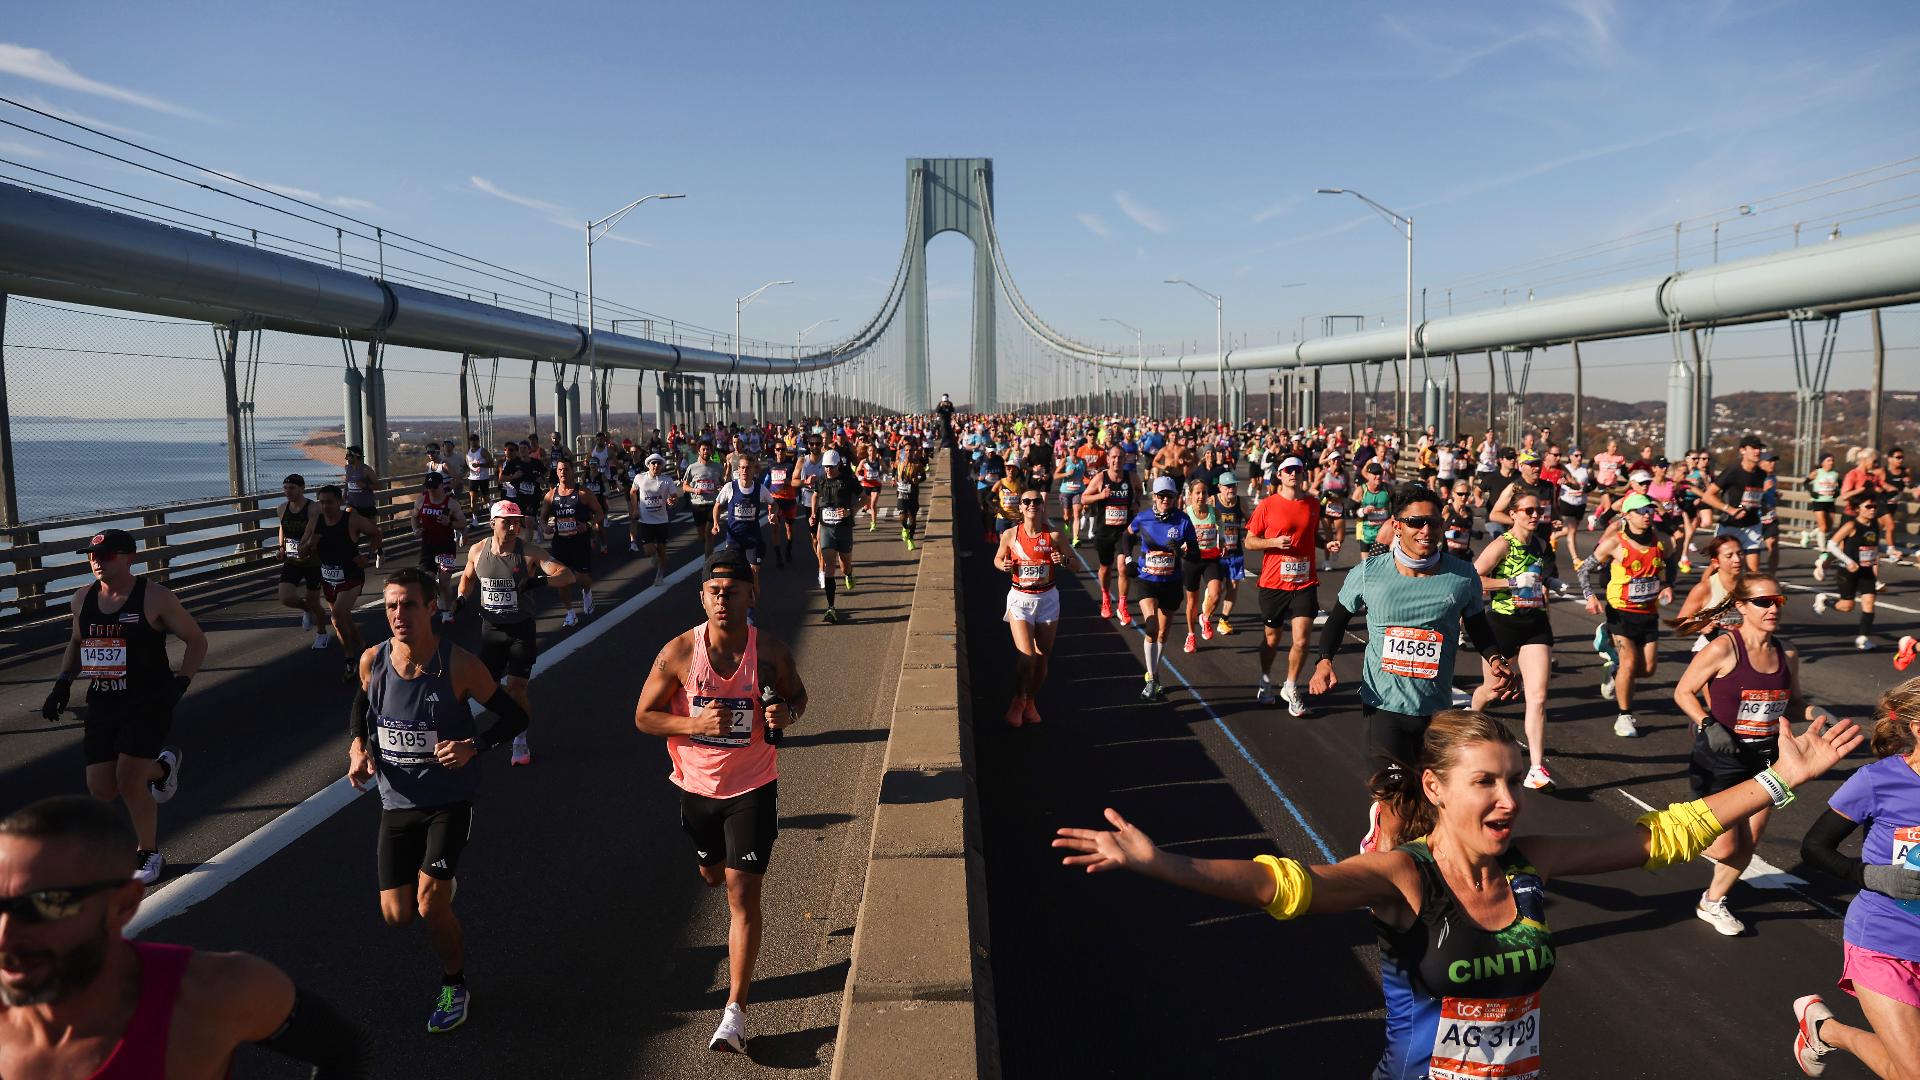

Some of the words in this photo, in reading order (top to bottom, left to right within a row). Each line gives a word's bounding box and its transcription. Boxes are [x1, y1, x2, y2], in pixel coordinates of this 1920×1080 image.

[488, 593, 512, 602] 4879
[90, 624, 122, 636] FDNY
[84, 648, 122, 660] 14537
[1389, 638, 1436, 658] 14585
[1741, 702, 1760, 714] AG
[388, 730, 426, 747] 5195
[1908, 828, 1920, 840] tc
[1448, 945, 1554, 984] CINTIA
[1458, 1001, 1482, 1018] tcs
[1442, 1024, 1482, 1048] AG
[1488, 1015, 1536, 1048] 3129
